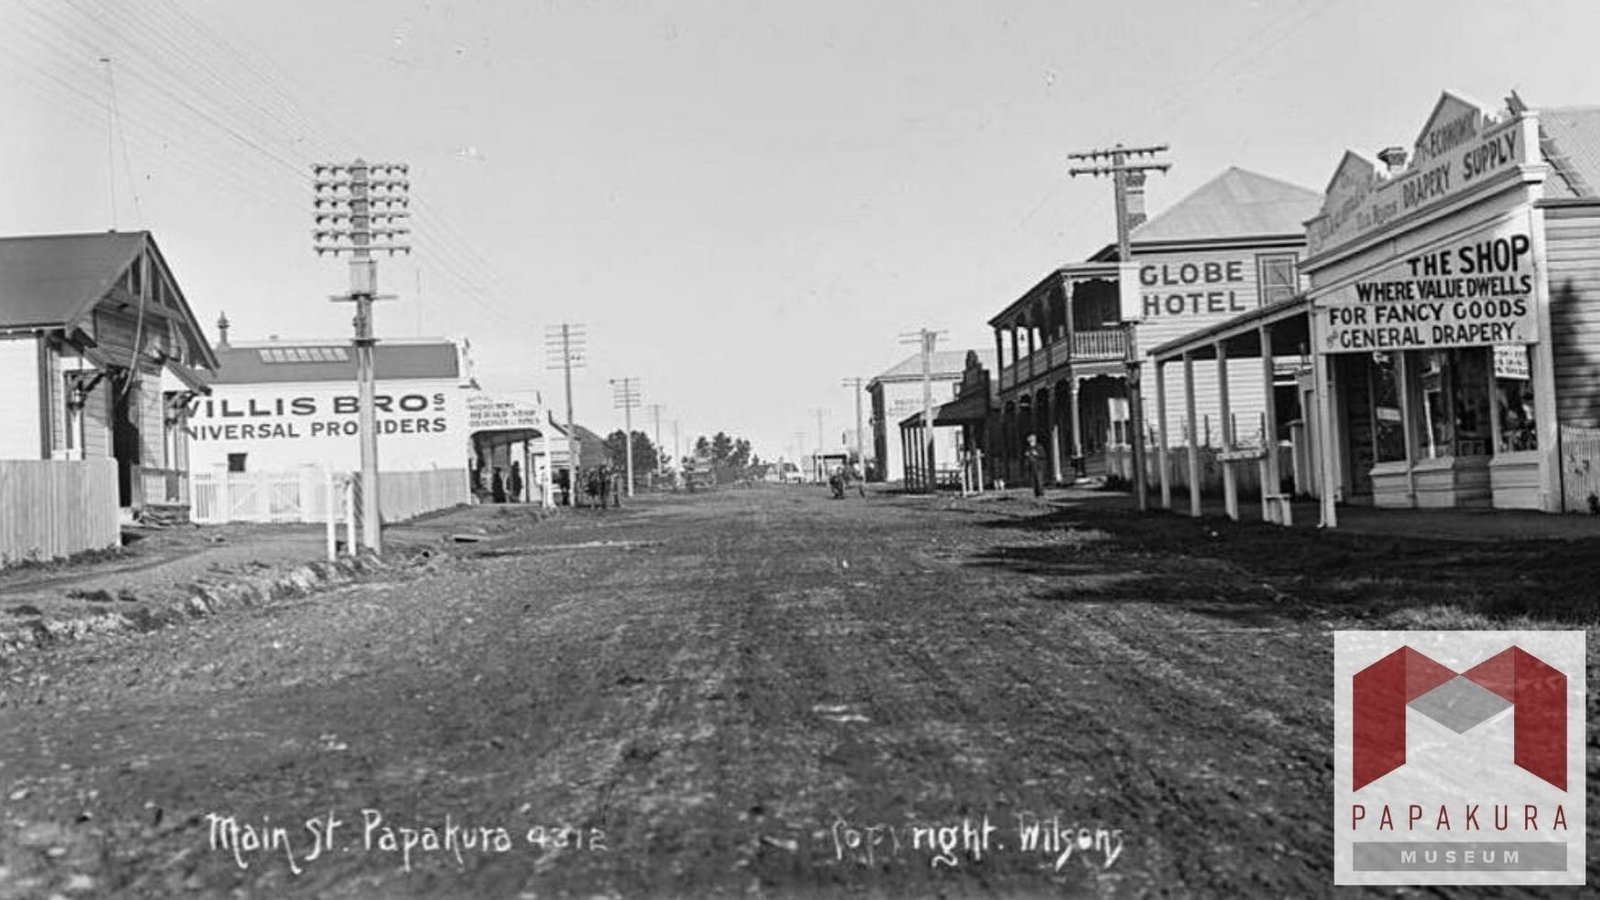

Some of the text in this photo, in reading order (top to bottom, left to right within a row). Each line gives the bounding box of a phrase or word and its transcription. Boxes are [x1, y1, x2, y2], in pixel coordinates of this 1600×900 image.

[1403, 163, 1450, 209] DRAPERY
[1463, 131, 1516, 180] SUPPLY
[1407, 234, 1529, 276] THE SHOP
[1139, 261, 1243, 285] GLOBE
[1356, 275, 1532, 302] WHERE VALUE DWELLS
[1143, 291, 1246, 316] HOTEL
[1329, 299, 1527, 325] FOR FANCY GOODS
[1340, 326, 1425, 348] GENERAL
[1433, 322, 1522, 344] DRAPERY.
[181, 423, 300, 441] NIVERSAL
[311, 418, 447, 437] PROIDERS
